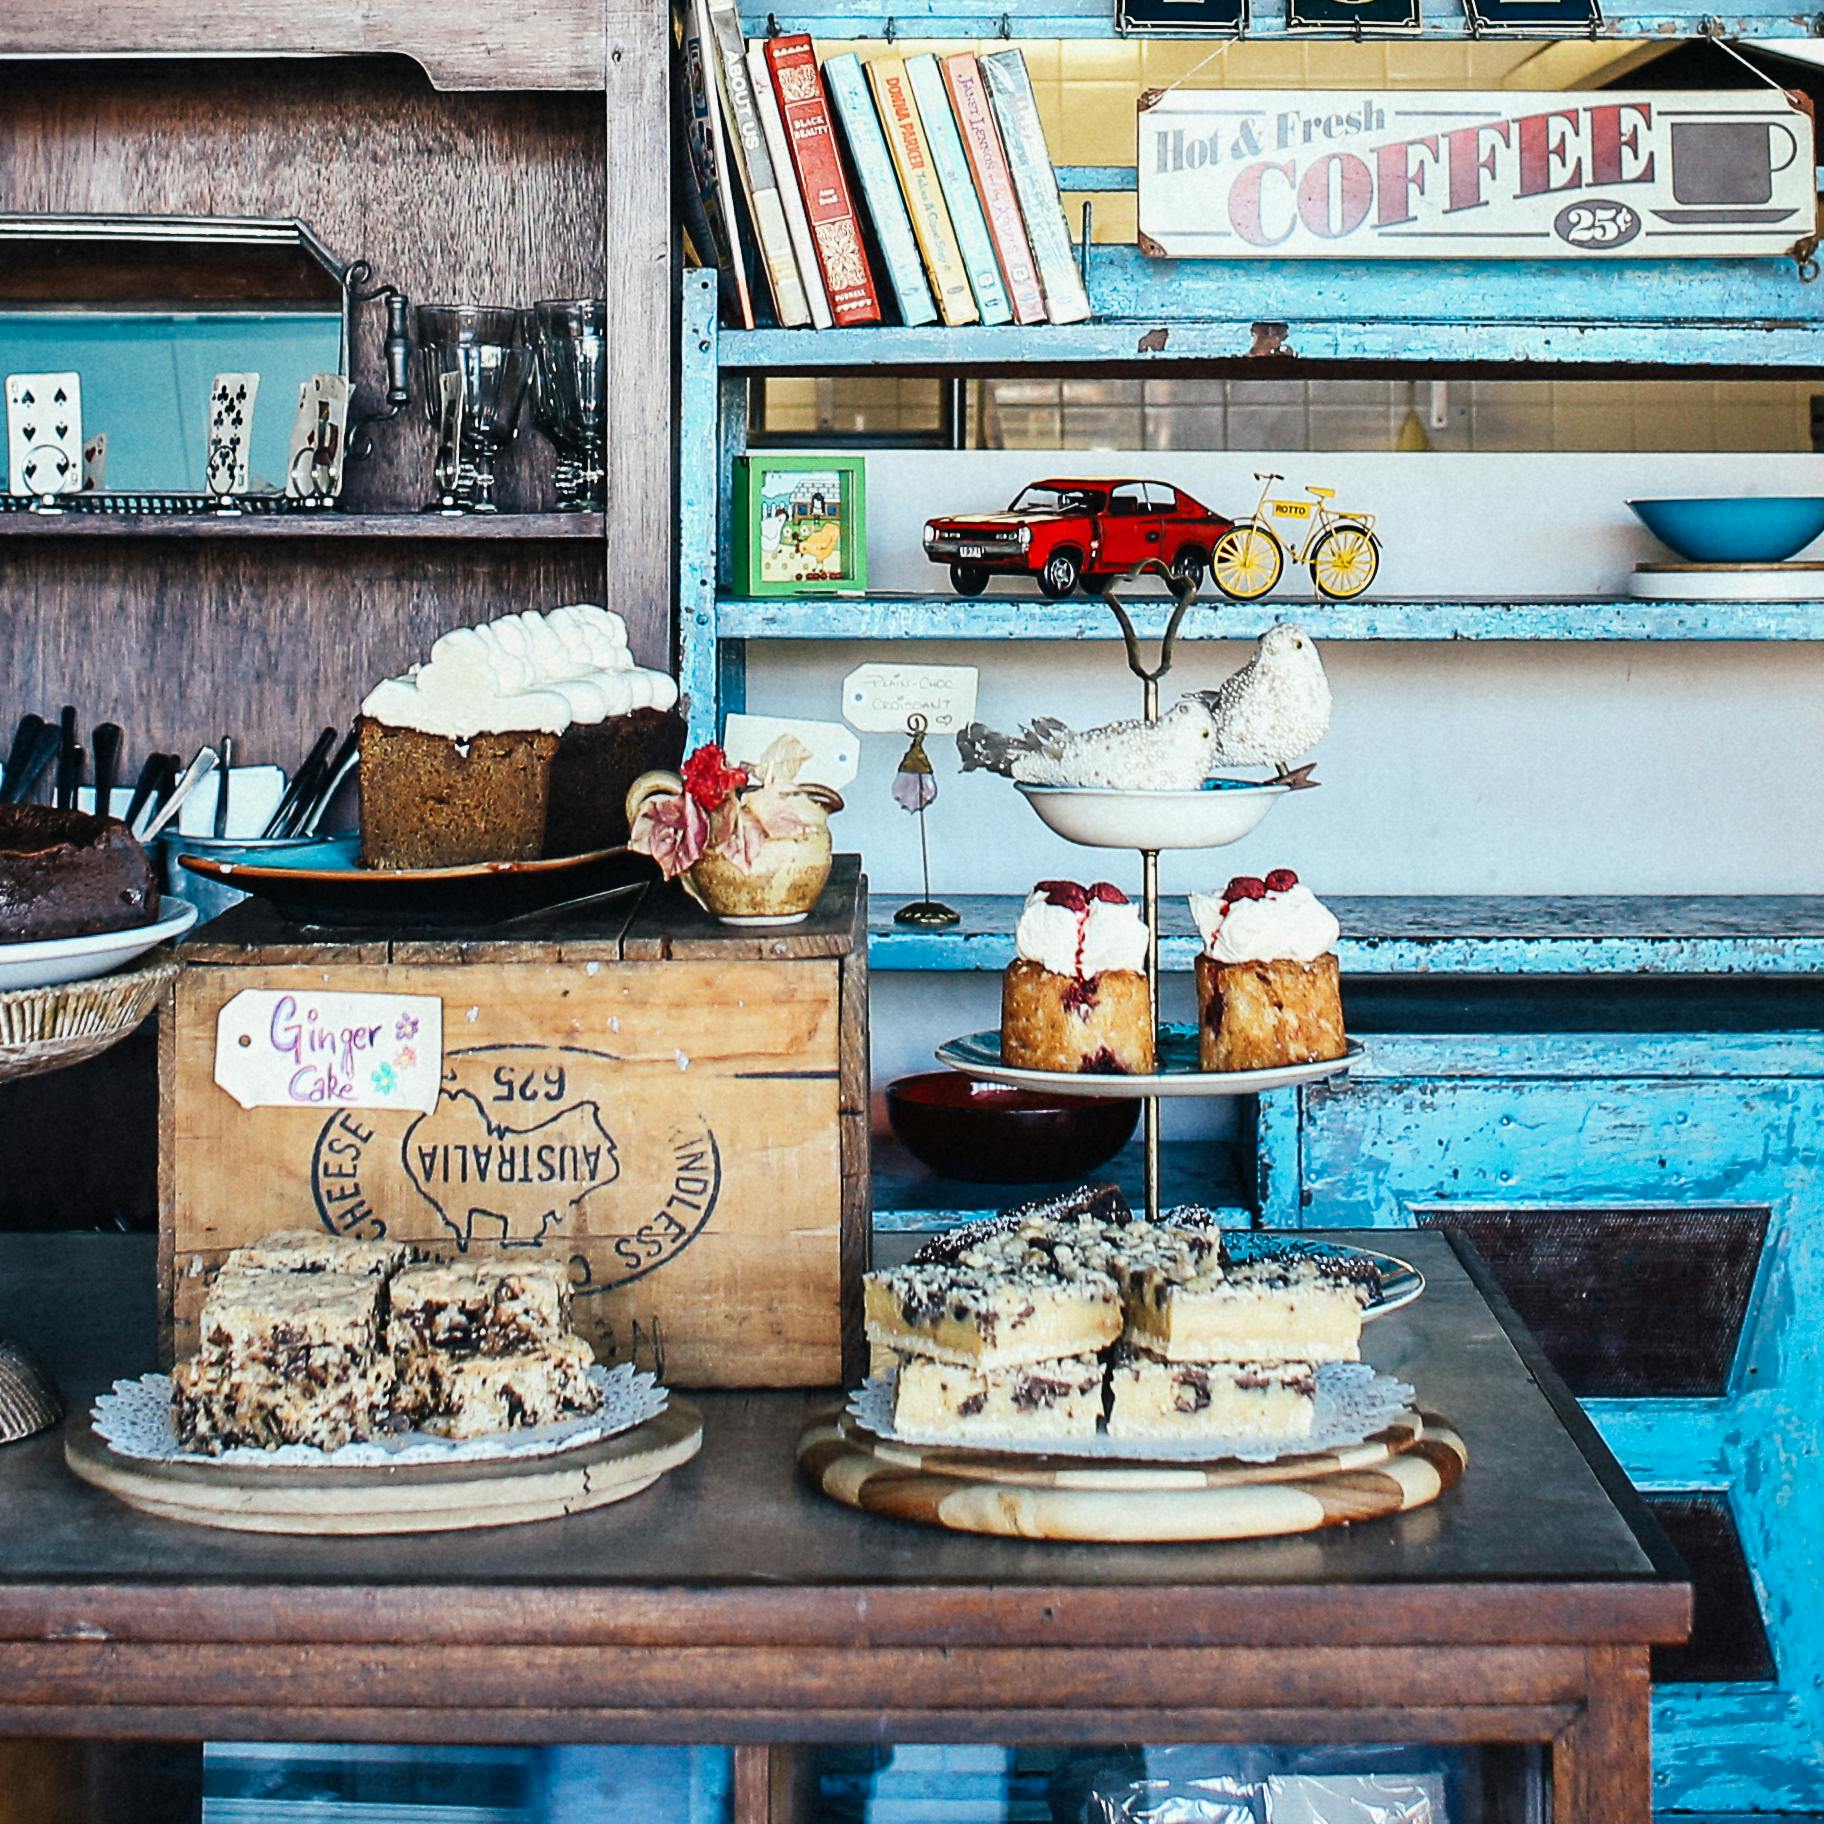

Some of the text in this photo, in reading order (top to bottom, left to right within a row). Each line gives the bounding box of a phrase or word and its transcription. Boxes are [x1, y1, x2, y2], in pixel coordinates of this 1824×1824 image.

[724, 49, 760, 151] ABOUT US
[793, 115, 825, 130] BLACK
[885, 75, 910, 122] DONNA
[899, 116, 925, 170] PARKER
[793, 125, 830, 141] BEAUTY
[1153, 100, 1387, 175] Hot & Fresh
[1227, 101, 1657, 248] COFFEE
[1276, 504, 1306, 516] ROTTO
[270, 994, 384, 1079] Ginger
[288, 1062, 359, 1104] Cake
[417, 1144, 604, 1183] AUSTRALIA
